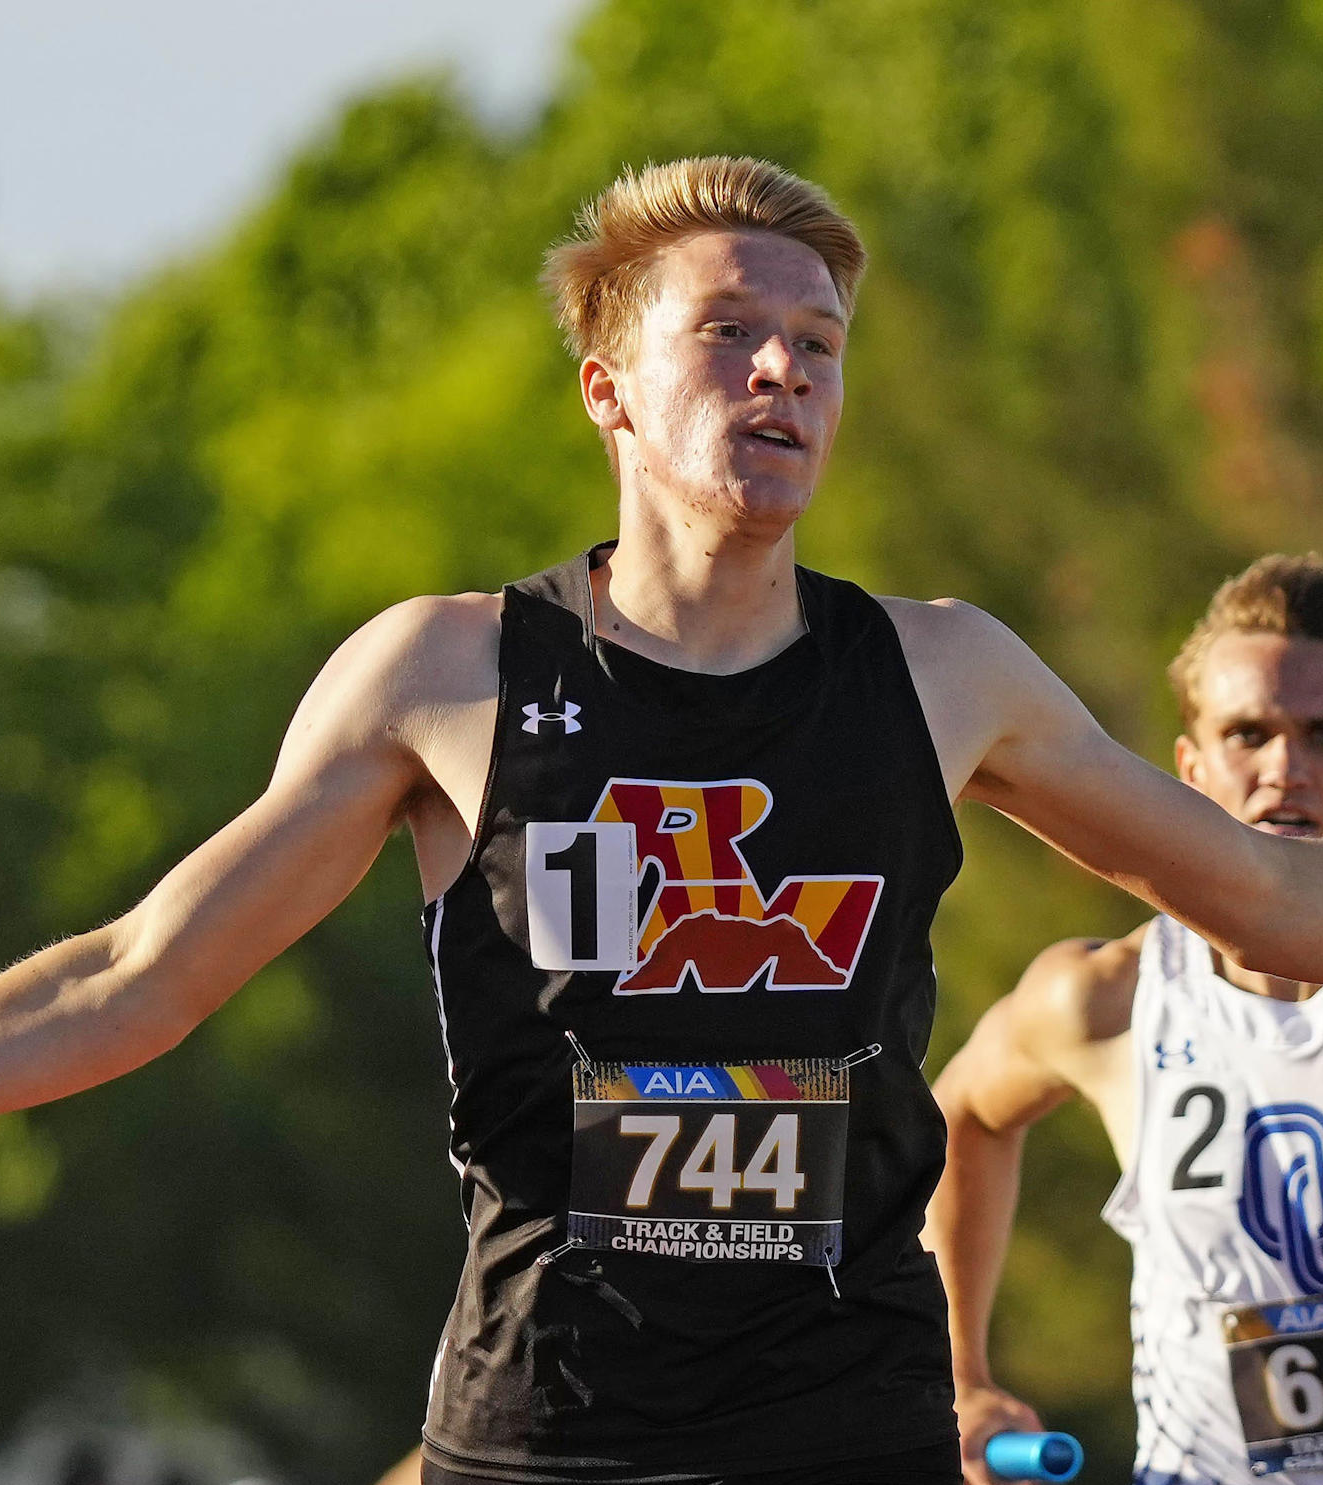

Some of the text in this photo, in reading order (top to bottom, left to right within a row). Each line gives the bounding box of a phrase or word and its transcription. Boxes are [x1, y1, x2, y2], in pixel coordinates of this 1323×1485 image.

[544, 831, 598, 961] 1
[643, 1070, 716, 1095] AIA
[619, 1112, 806, 1209] 744
[1172, 1086, 1227, 1191] 2
[611, 1235, 804, 1262] CHAMPIONSHIPS
[621, 1219, 795, 1243] TRACK & FIELD
